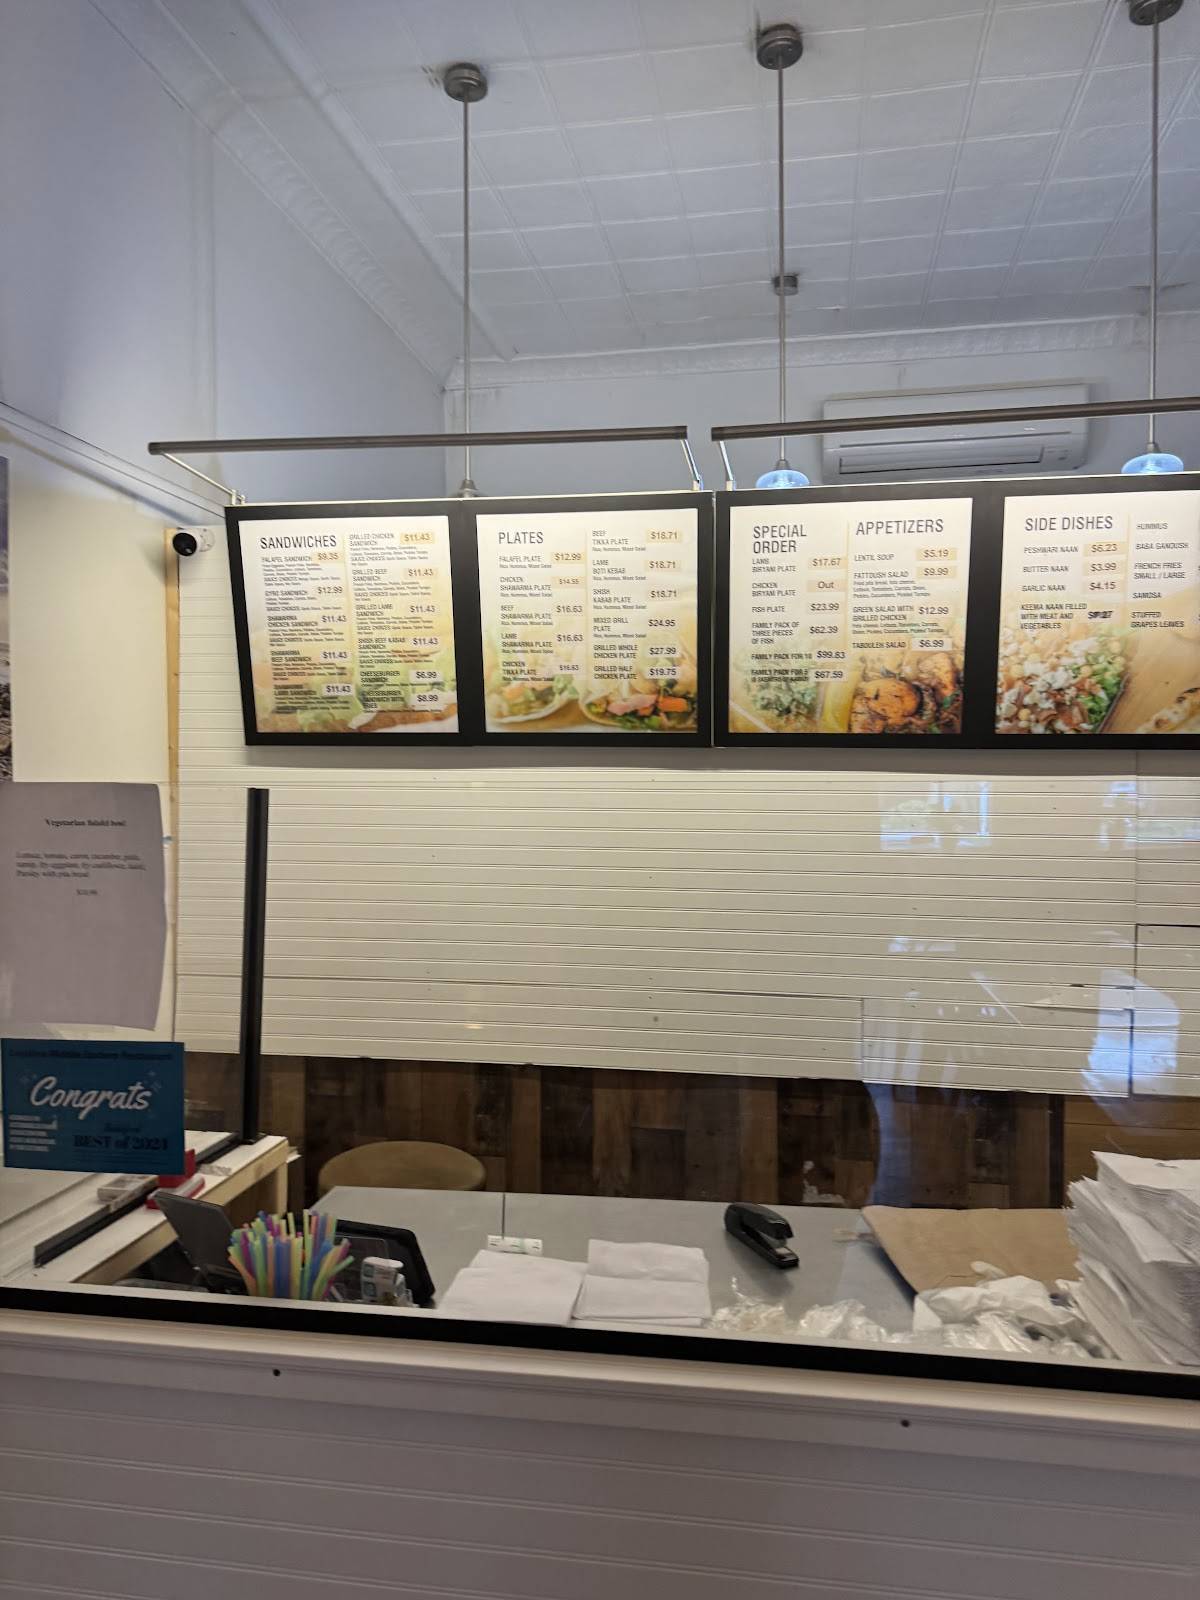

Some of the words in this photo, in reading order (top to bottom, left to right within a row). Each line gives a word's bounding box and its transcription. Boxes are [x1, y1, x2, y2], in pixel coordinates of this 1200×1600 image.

[856, 519, 944, 535] APPETIZERS
[1025, 518, 1057, 531] SIDE
[1062, 516, 1113, 530] DISHES
[753, 524, 807, 539] SPECIAL
[260, 535, 337, 549] SANDWICHES
[498, 532, 543, 544] PLATES
[753, 540, 797, 554] ORDER
[1091, 544, 1117, 553] $6.23
[924, 549, 949, 557] $5.19
[812, 558, 841, 566] $17.67
[1091, 563, 1116, 572] $3.99
[924, 568, 948, 576] $9.99
[317, 586, 343, 594] $12.99
[1090, 582, 1116, 590] $4.15
[651, 590, 677, 598] $18.71
[811, 603, 839, 611] $23.99
[810, 626, 838, 634] $62.39
[650, 647, 676, 655] $27.99
[326, 685, 351, 693] $11.43
[30, 1076, 152, 1120] Congrats
